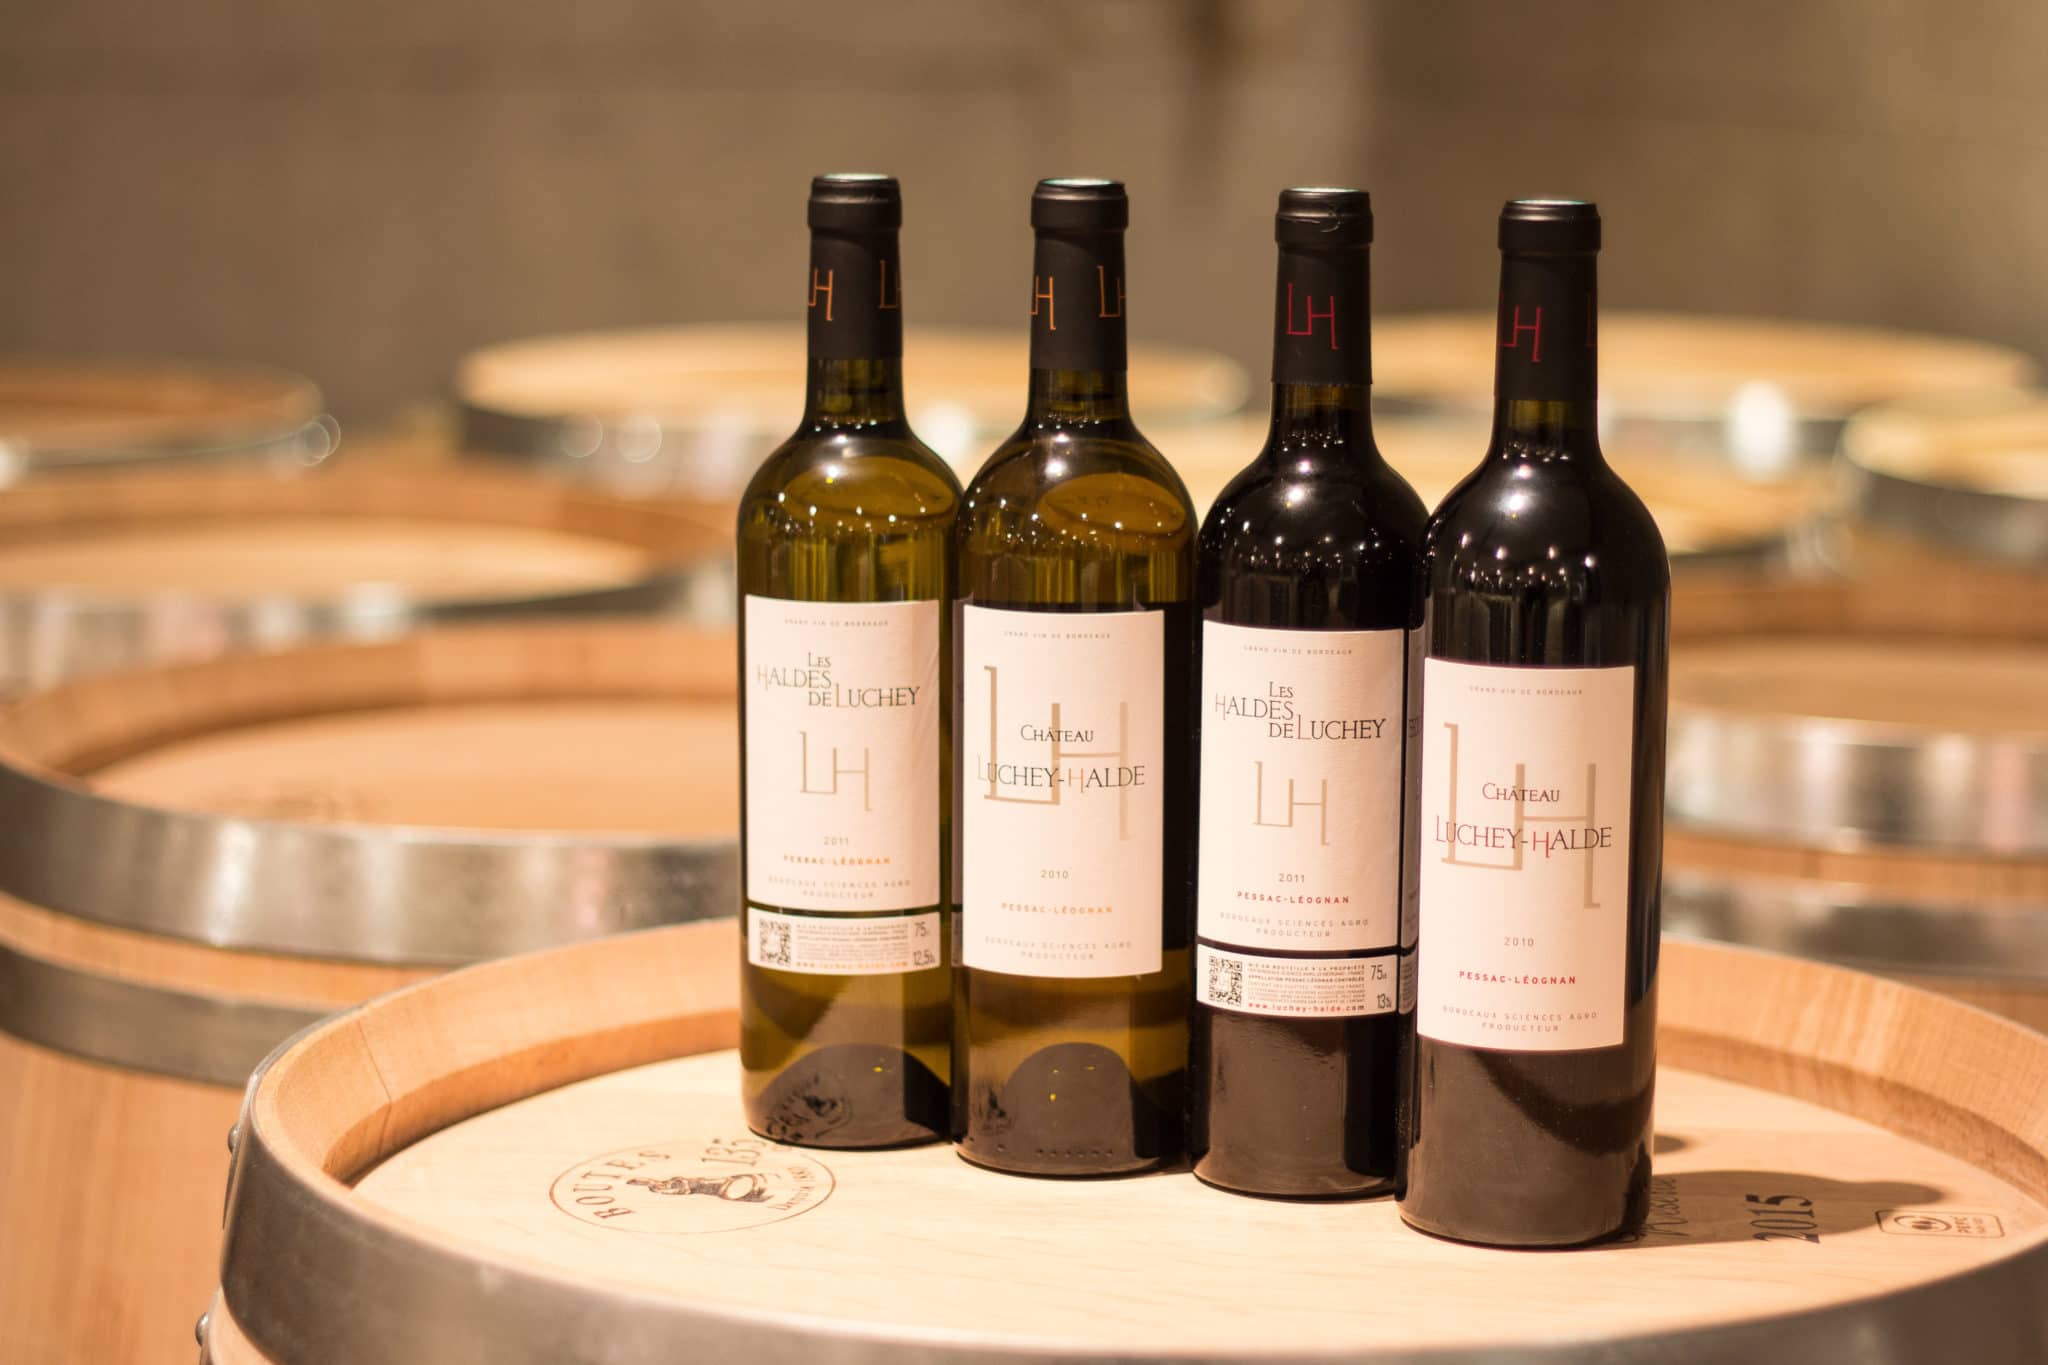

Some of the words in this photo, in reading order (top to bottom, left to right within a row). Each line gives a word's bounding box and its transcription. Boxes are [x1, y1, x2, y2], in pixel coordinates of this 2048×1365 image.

[1286, 282, 1338, 350] LH
[757, 664, 832, 691] HALDES
[835, 682, 921, 708] LUCHEY
[1215, 693, 1294, 721] HALDES
[1298, 714, 1387, 740] LUCHEY
[799, 731, 872, 812] LH
[977, 754, 1145, 793] LUCHEY-HALDE
[1253, 761, 1330, 846] LH
[823, 836, 849, 846] 2011
[1435, 814, 1612, 858] LUCHEY-HALDE
[1040, 869, 1069, 879] 2010
[1277, 873, 1305, 883] 2011
[1237, 890, 1350, 904] PESSAC-LÉOGNAN
[1503, 937, 1534, 947] 2010
[1459, 971, 1577, 985] PESSAC-LÉOGNAN
[1504, 1012, 1563, 1022] SCIENCES
[1745, 1193, 1821, 1244] 2015
